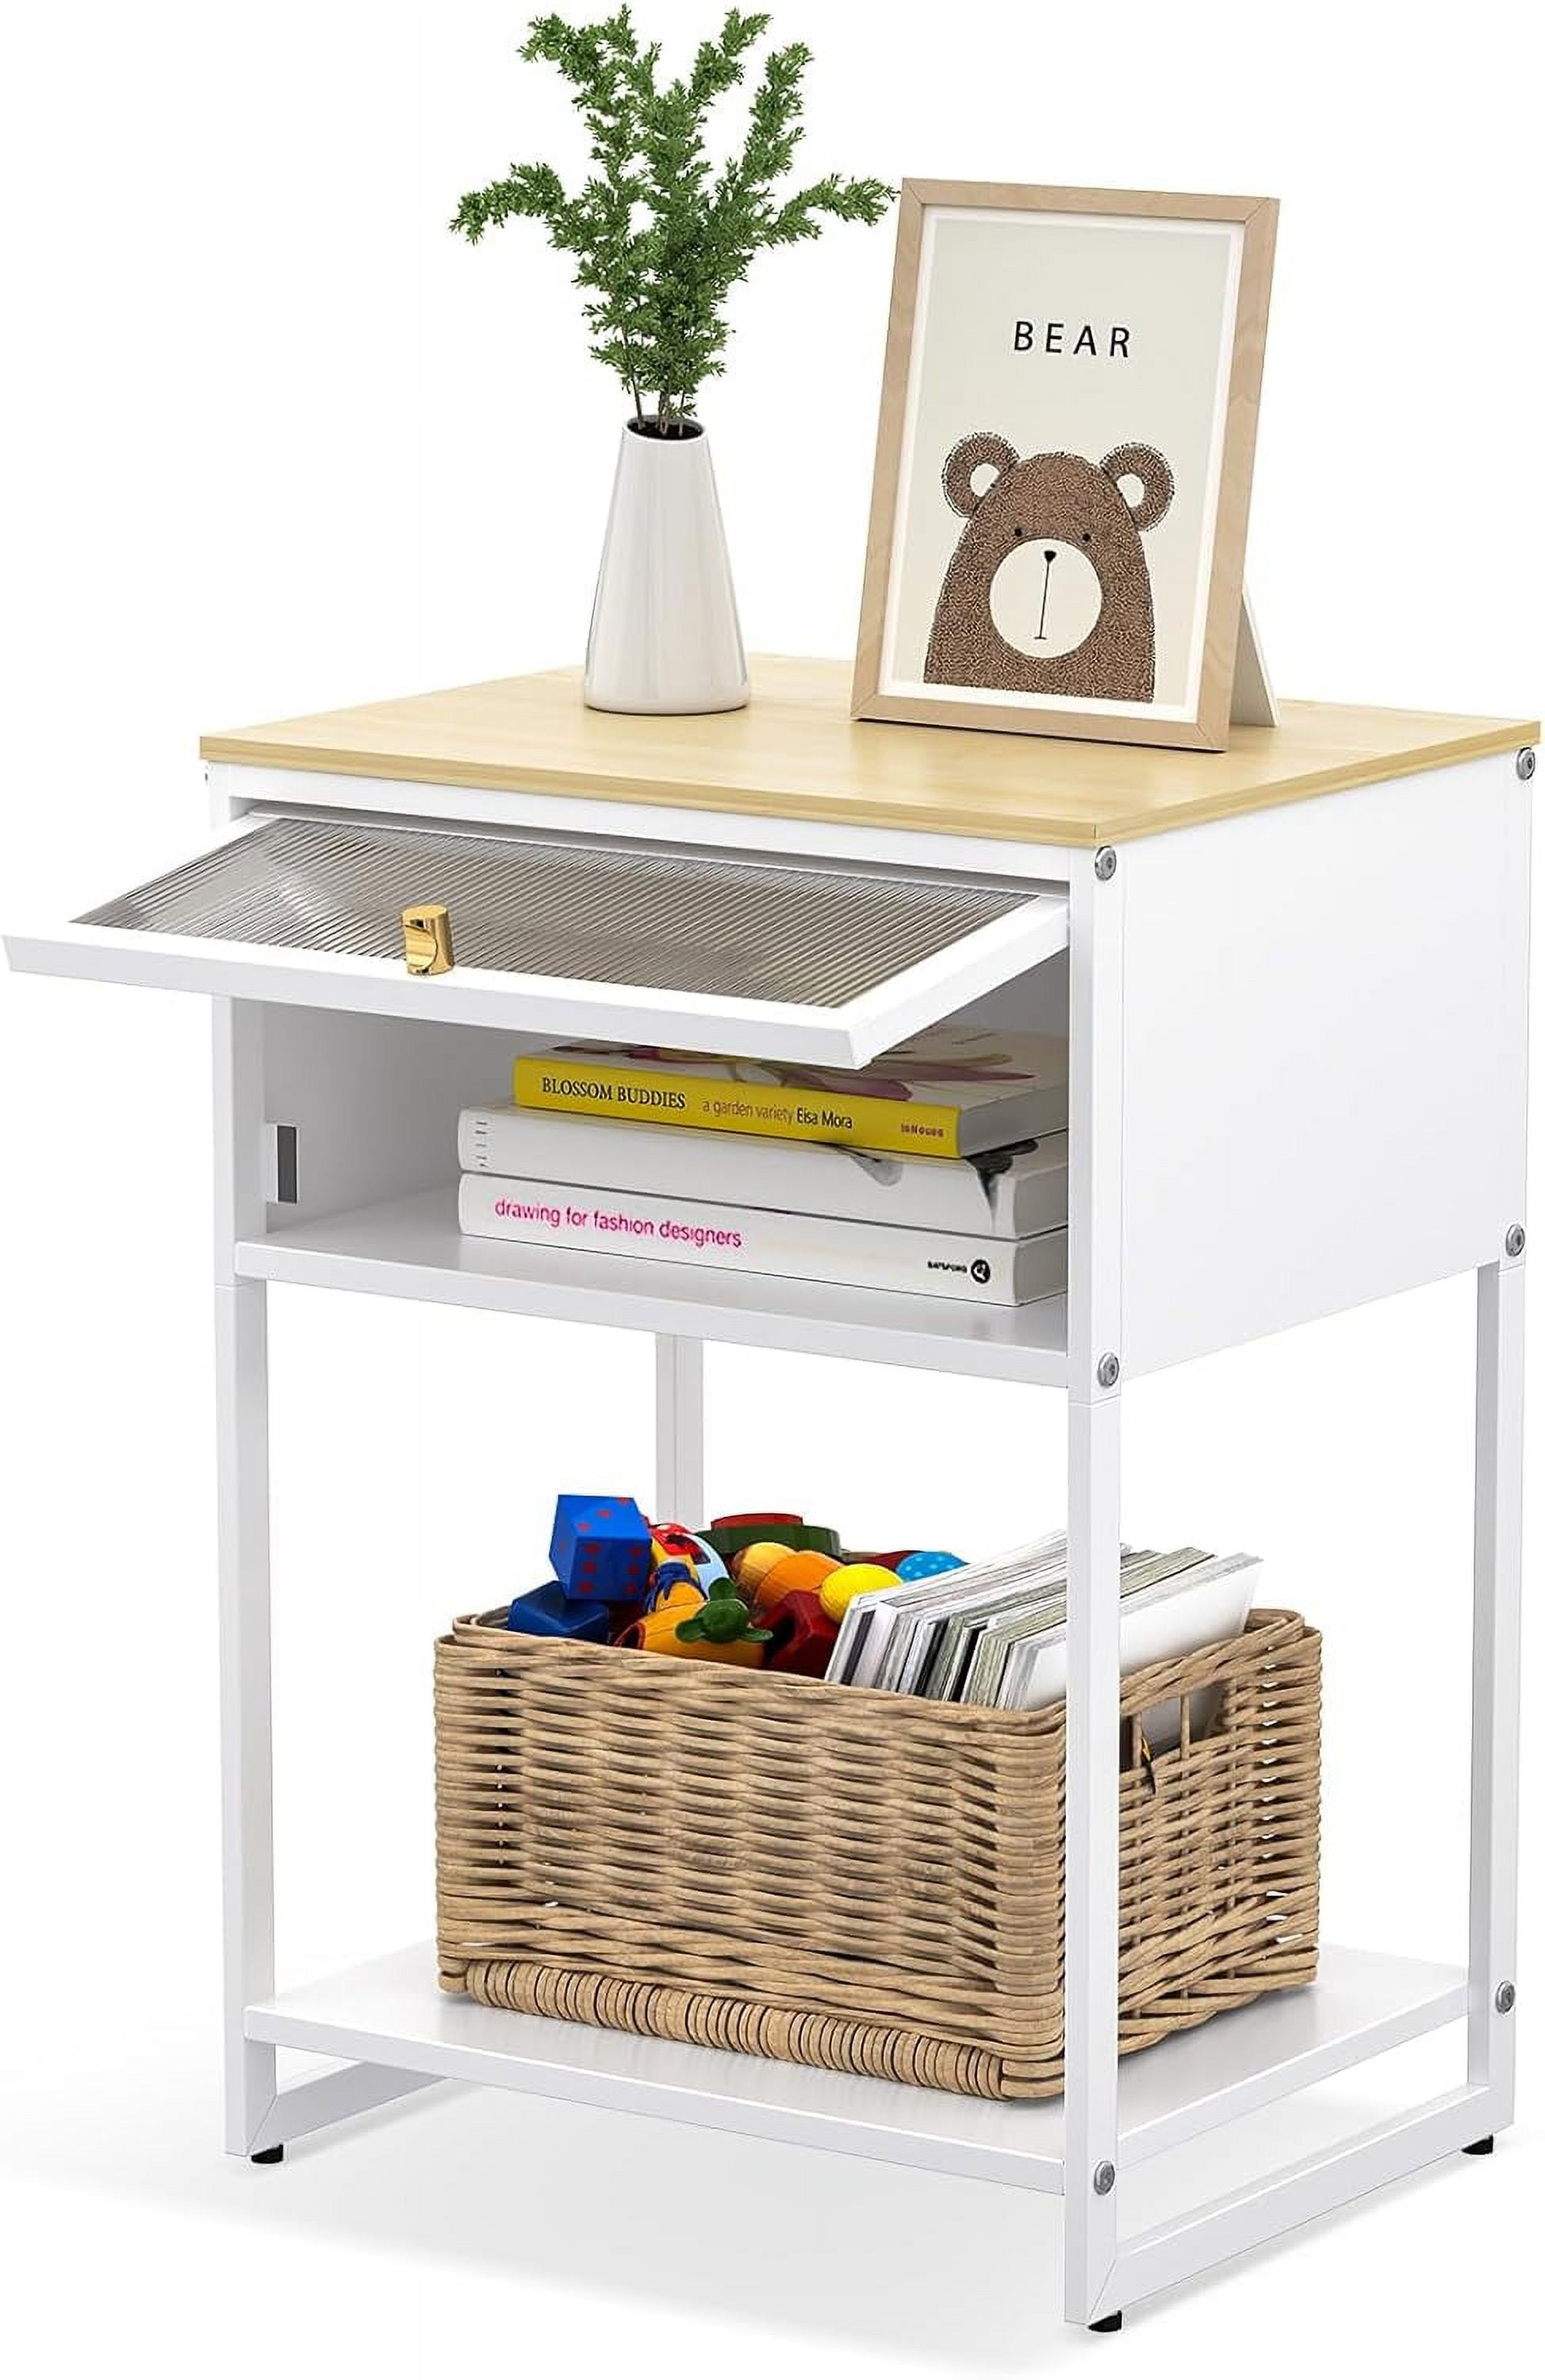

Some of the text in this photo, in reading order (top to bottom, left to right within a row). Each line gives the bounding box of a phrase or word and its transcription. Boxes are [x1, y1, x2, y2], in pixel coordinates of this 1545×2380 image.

[1014, 321, 1131, 358] BEAR
[542, 1077, 613, 1101] BLOSSOM
[617, 1085, 687, 1109] BUDDIES
[703, 1100, 711, 1112] a
[713, 1100, 753, 1118] garden
[822, 1111, 853, 1129] Mora
[495, 1199, 742, 1248] drawing for fashion designers
